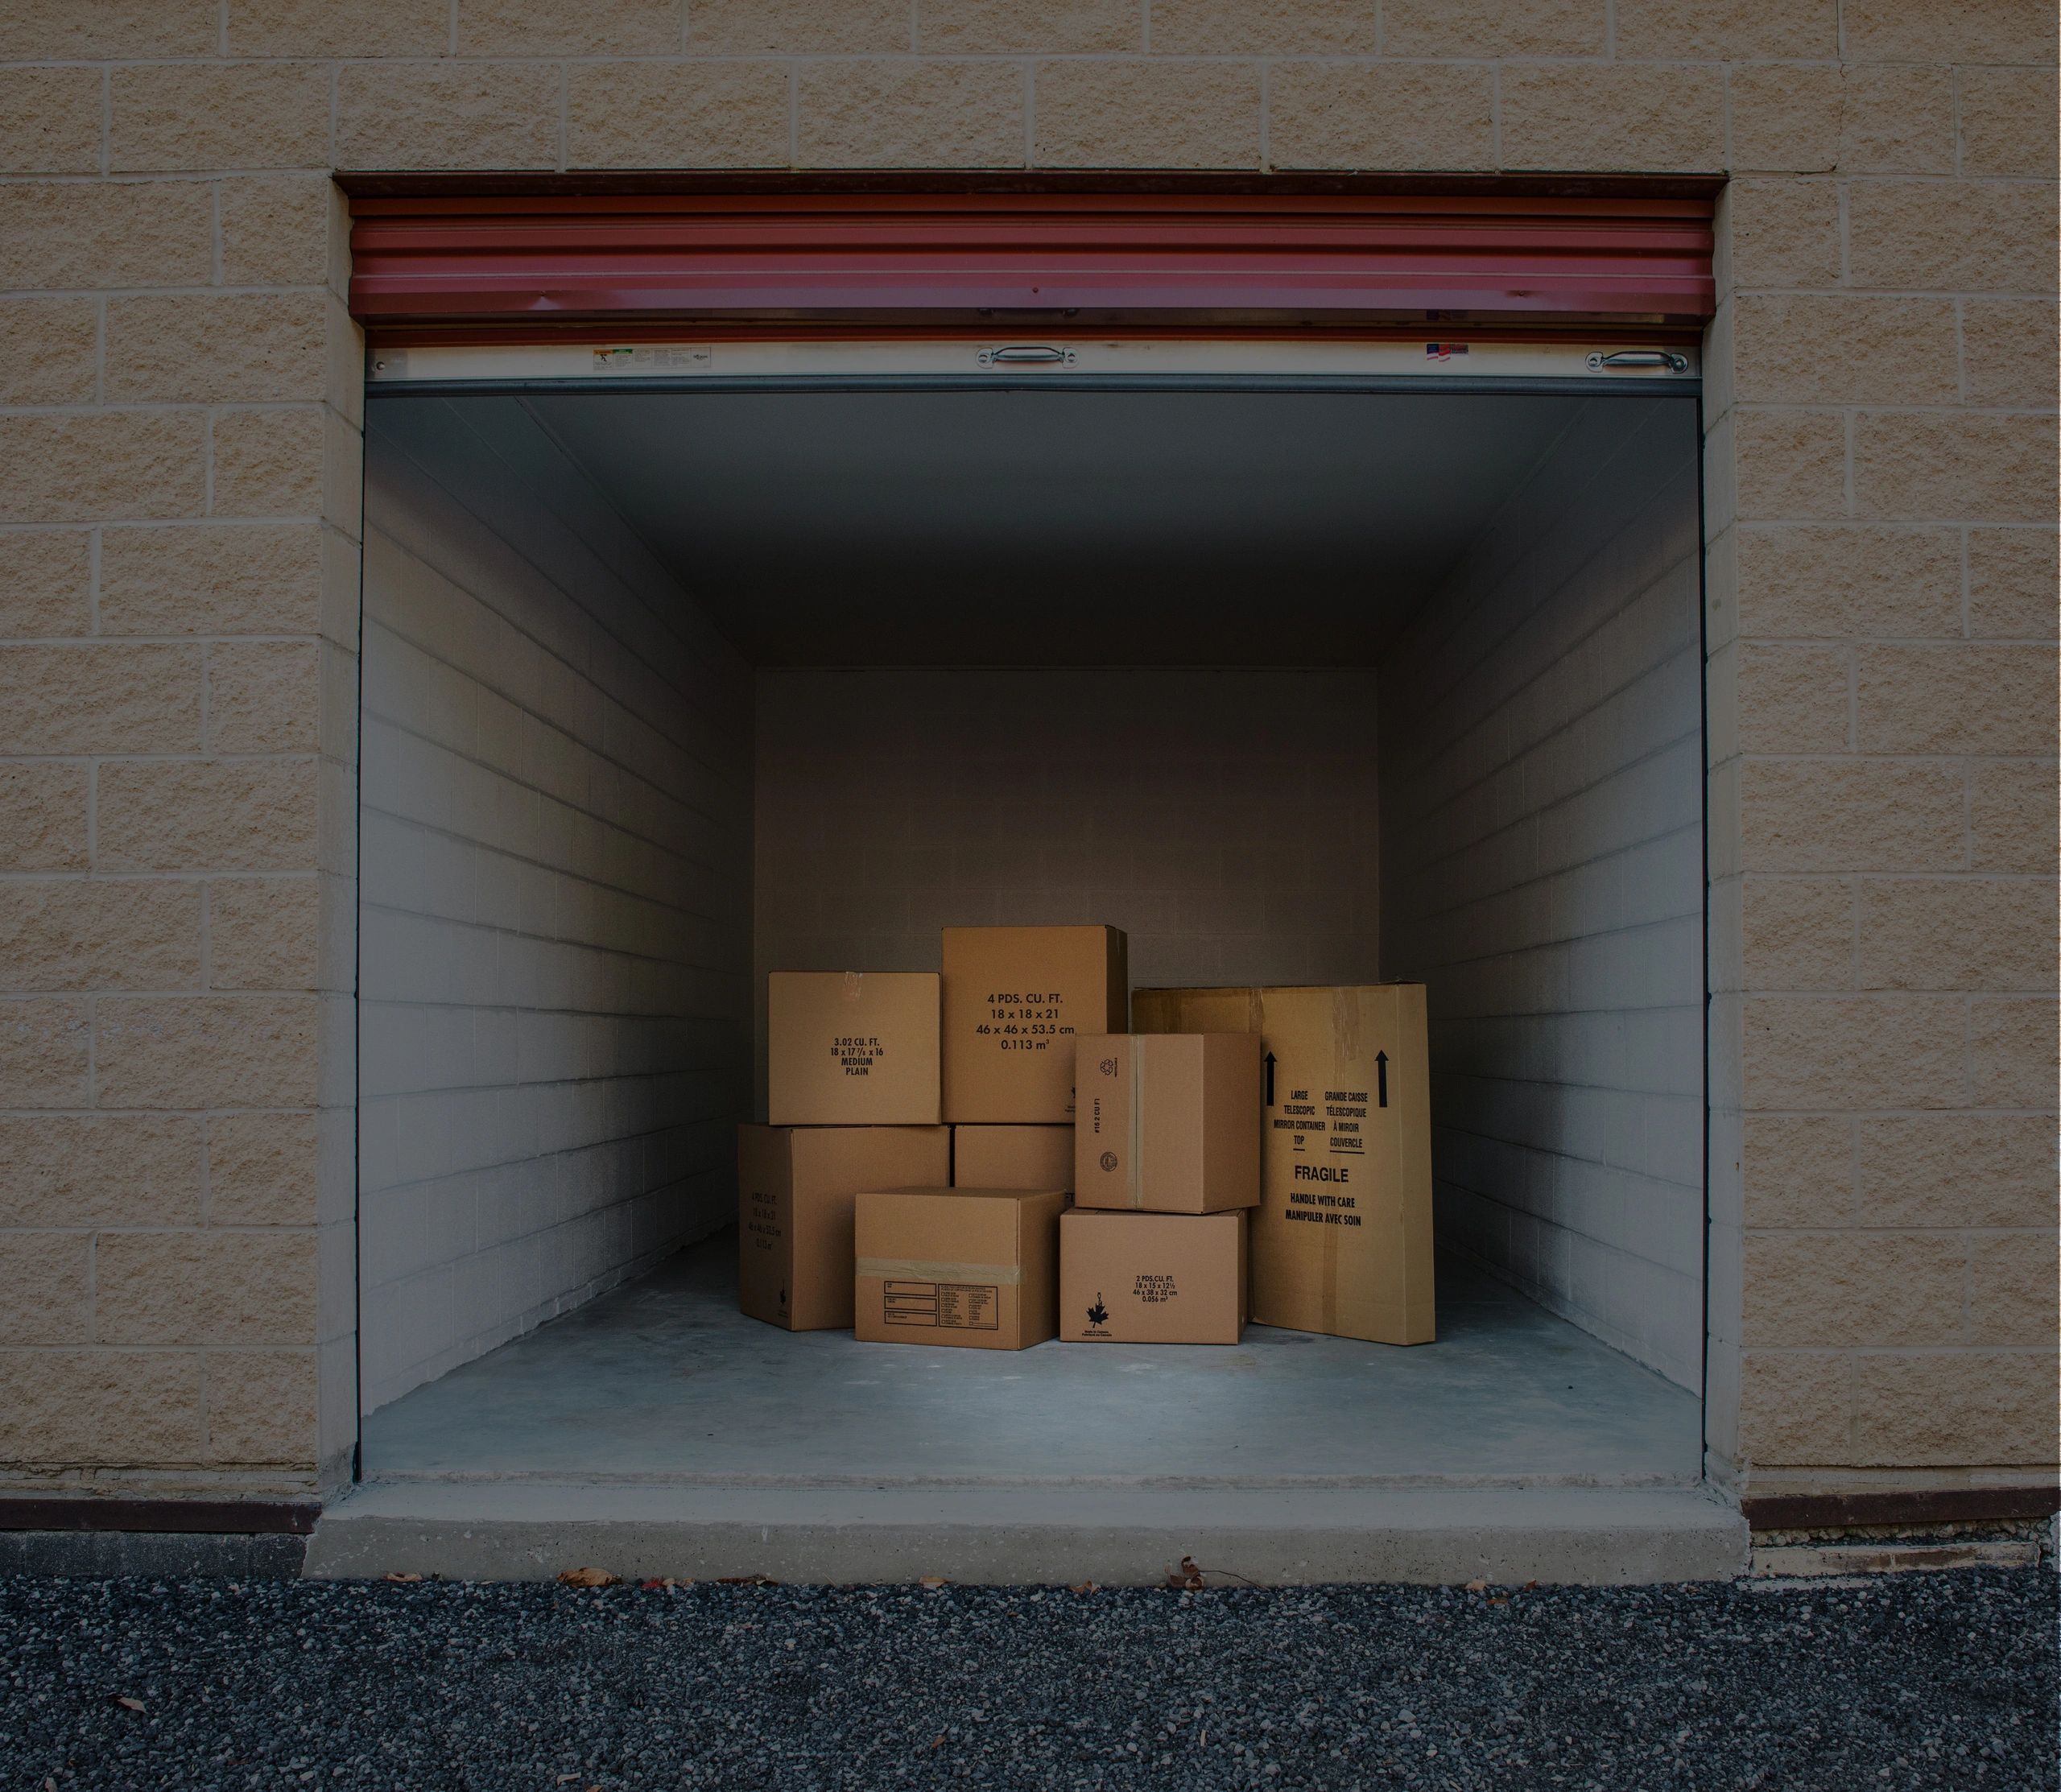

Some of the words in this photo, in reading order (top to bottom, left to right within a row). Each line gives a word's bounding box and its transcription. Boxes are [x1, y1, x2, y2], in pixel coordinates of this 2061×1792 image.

[988, 994, 994, 1003] 4
[998, 994, 1022, 1003] PDS.
[1026, 994, 1045, 1003] CU.
[1049, 994, 1063, 1003] FT.
[992, 1010, 1004, 1018] 18
[1019, 1010, 1032, 1018] 18
[1046, 1010, 1059, 1018] 21
[977, 1025, 990, 1034] 46
[1004, 1025, 1018, 1034] 46
[1031, 1025, 1055, 1034] 53.5
[834, 1038, 852, 1046] 3.02
[854, 1038, 866, 1046] CU.
[869, 1038, 880, 1046] FT.
[1002, 1040, 1032, 1050] 0.113
[841, 1058, 873, 1066] MEDIUM
[846, 1067, 869, 1076] PLAIN
[1291, 1091, 1308, 1100] LARGE
[1325, 1092, 1347, 1102] GRANDE
[1349, 1092, 1368, 1102] CAISSE
[1094, 1107, 1100, 1115] CU
[1284, 1105, 1315, 1116] TELESCOPIC
[1327, 1105, 1366, 1117] TÉLESCOPIQUE
[1274, 1119, 1295, 1130] MIRROR
[1295, 1121, 1325, 1131] CONTAINER
[1333, 1121, 1338, 1132] À
[1339, 1122, 1359, 1133] MIROIR
[1294, 1136, 1304, 1145] TOP
[1330, 1138, 1363, 1148] COUVERCLE
[1295, 1166, 1349, 1183] FRAGILE
[1291, 1192, 1315, 1204] HANDLE
[1317, 1195, 1336, 1207] WITH
[1337, 1197, 1355, 1208] CARE
[1286, 1209, 1324, 1223] MANIPULER
[1325, 1213, 1342, 1224] AVEC
[1344, 1215, 1361, 1226] SOIN
